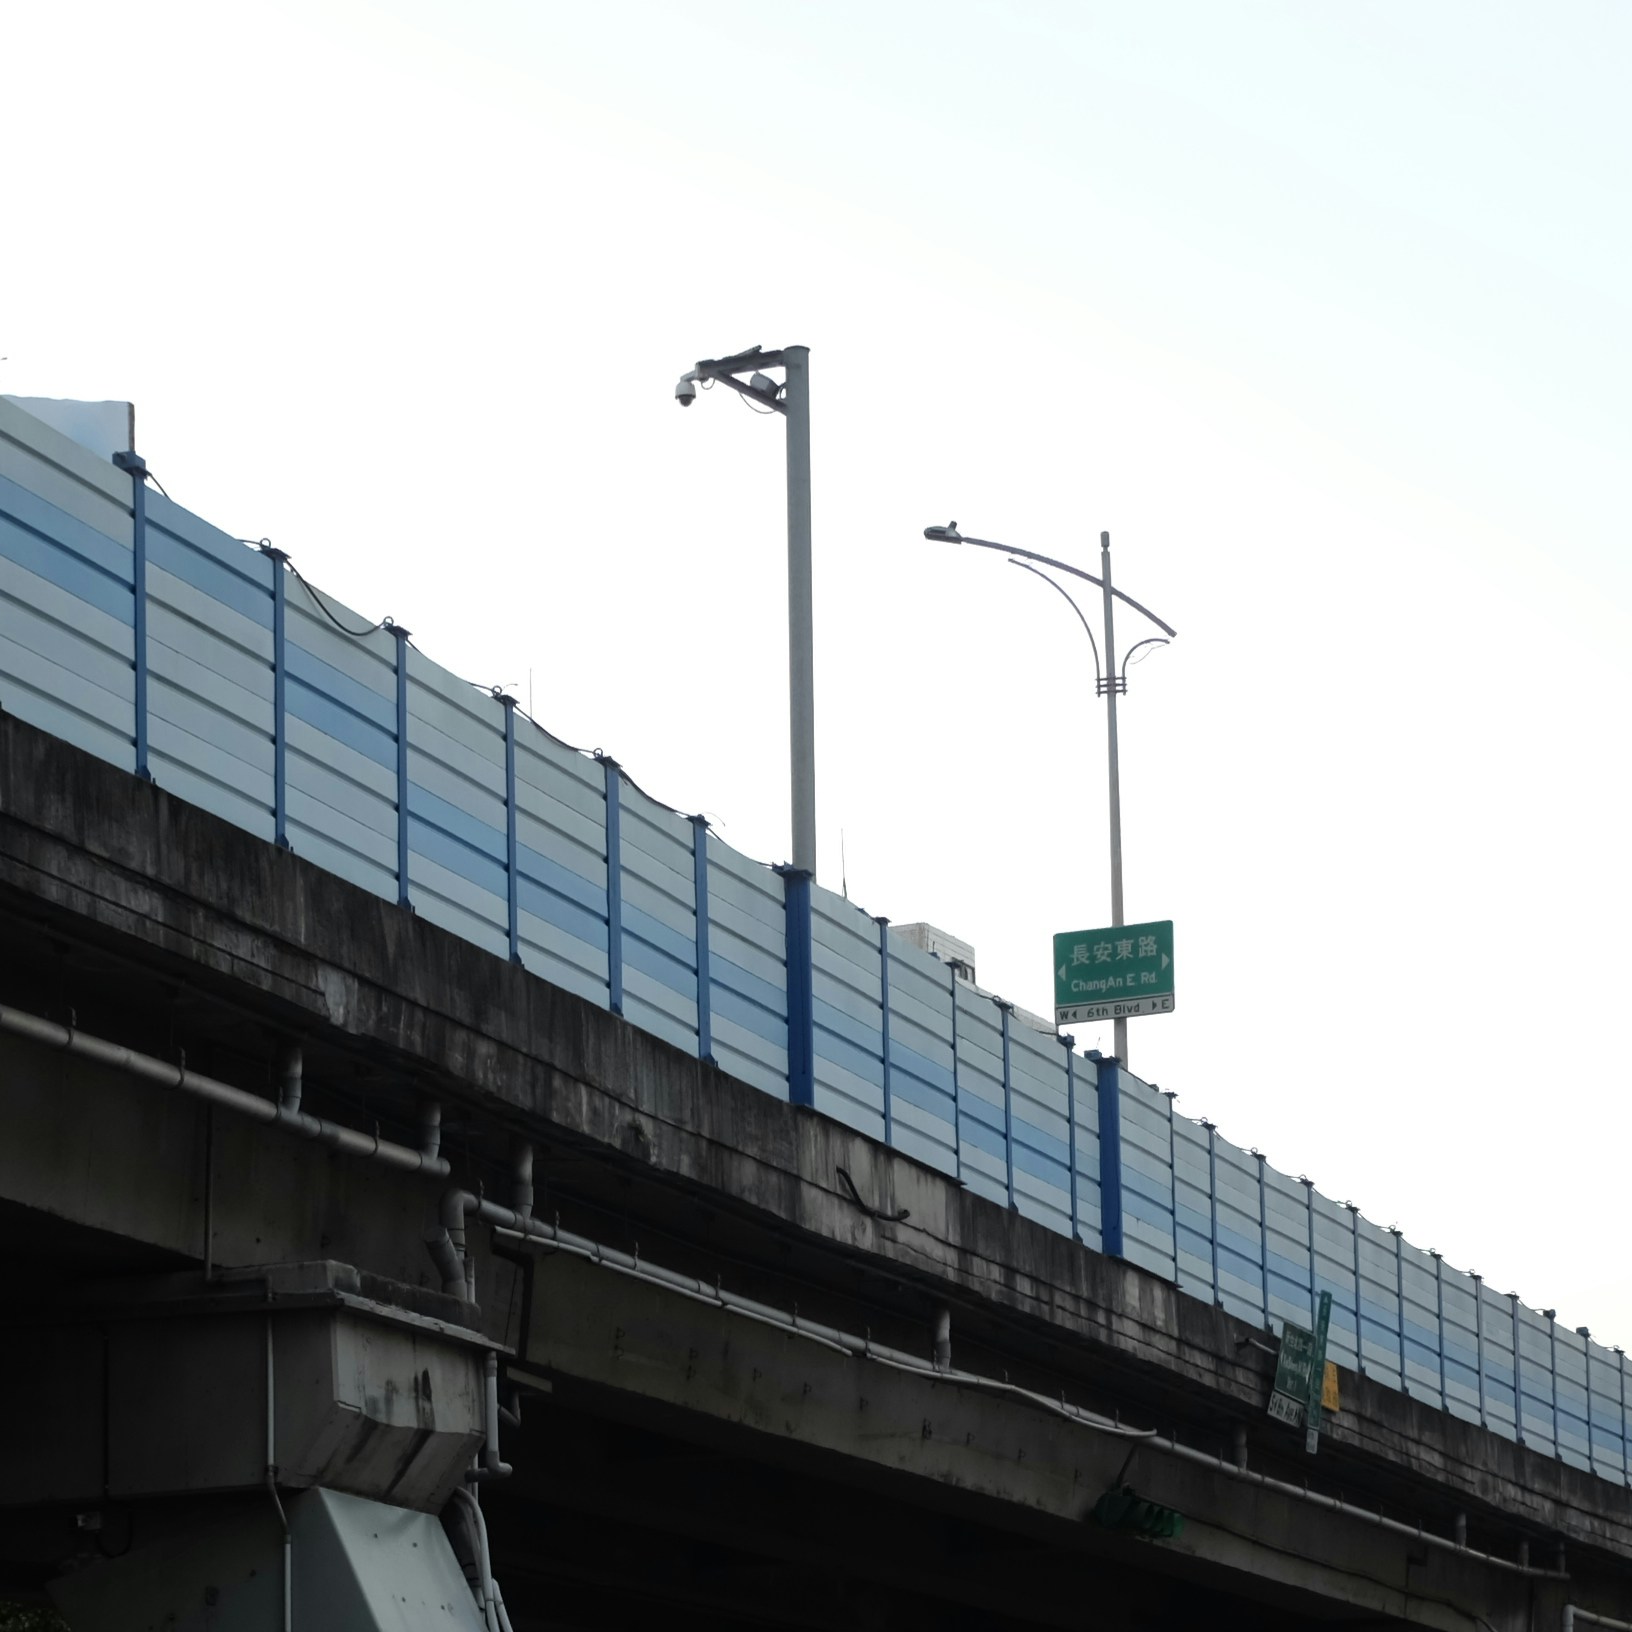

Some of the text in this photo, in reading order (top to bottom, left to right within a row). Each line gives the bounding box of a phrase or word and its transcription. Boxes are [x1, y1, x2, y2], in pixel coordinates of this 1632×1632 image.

[1070, 935, 1158, 966] 長安東路
[1071, 975, 1123, 993] ChangAn
[1141, 971, 1158, 984] Rd.
[1059, 1010, 1069, 1020] W
[1087, 1007, 1108, 1018] 6th
[1161, 998, 1170, 1009] E
